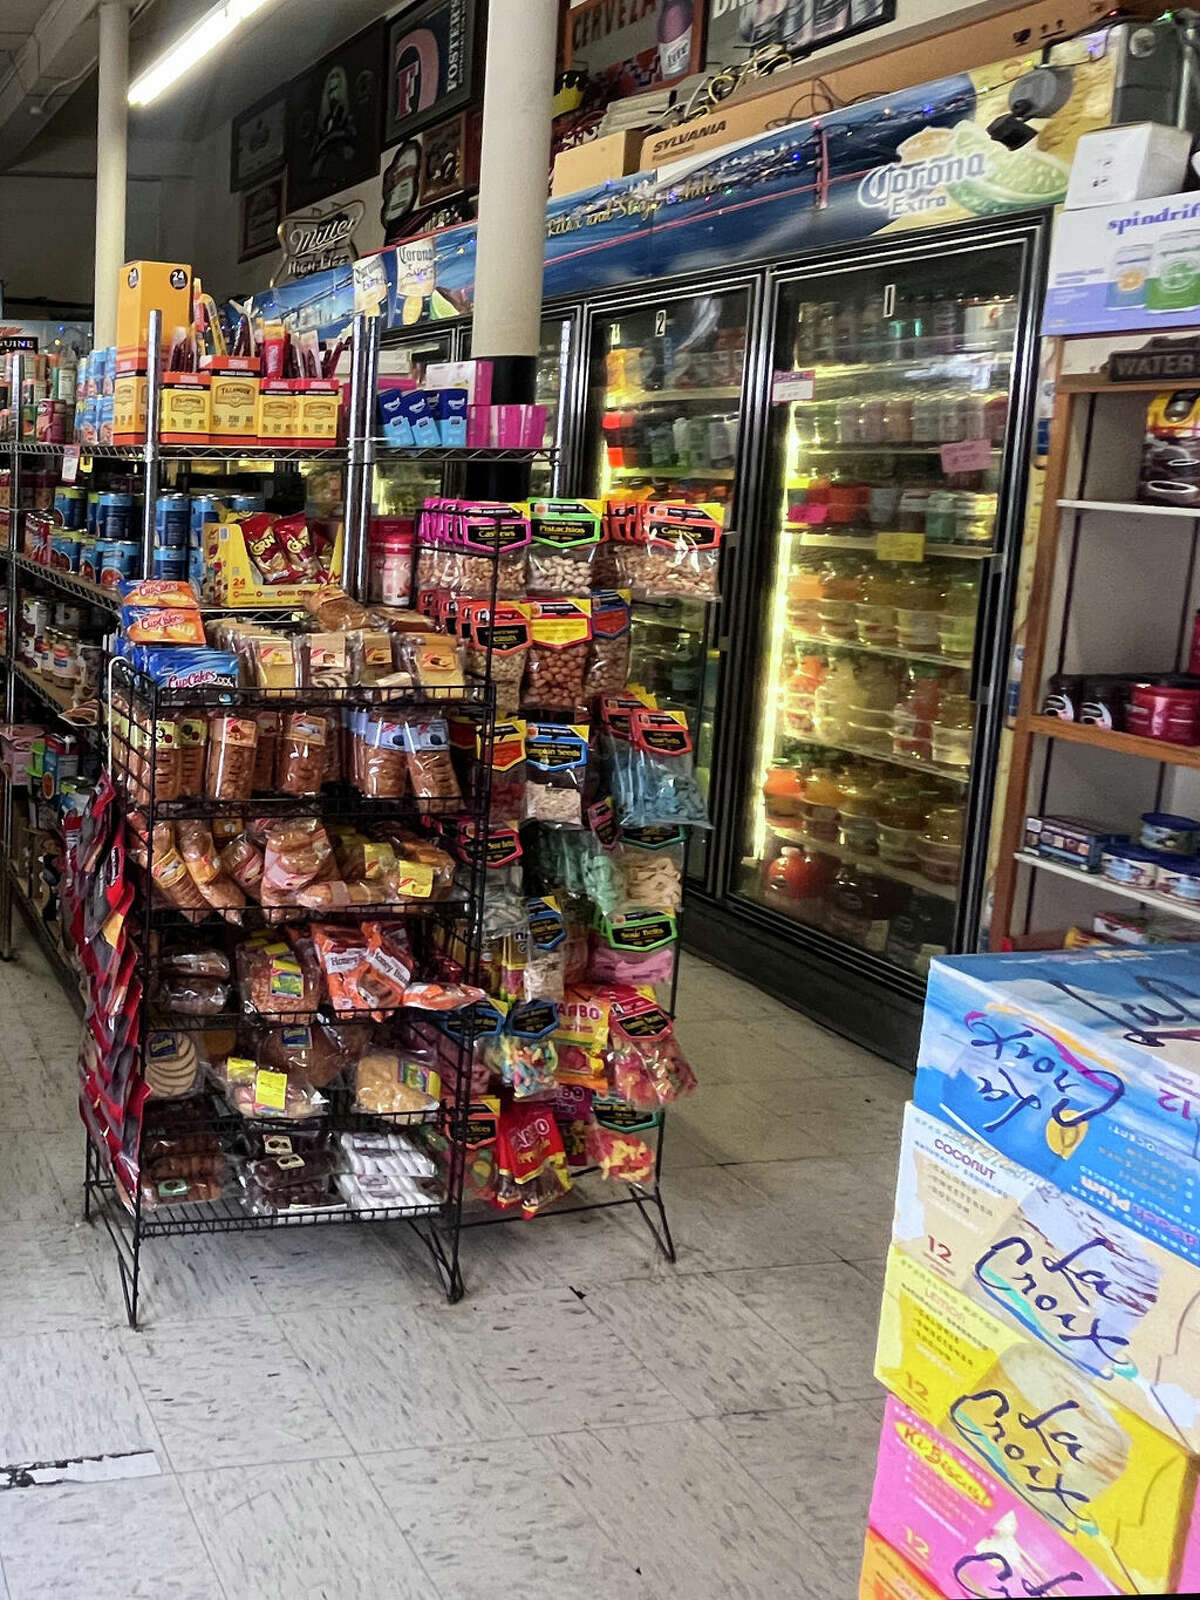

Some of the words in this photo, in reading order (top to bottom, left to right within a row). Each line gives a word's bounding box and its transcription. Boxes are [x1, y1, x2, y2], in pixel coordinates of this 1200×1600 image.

[654, 121, 727, 152] SYLVANIA
[858, 152, 986, 208] Corona
[888, 193, 947, 218] Extra
[1108, 203, 1200, 236] spindrif
[290, 217, 357, 256] Miller
[172, 271, 185, 281] 24
[656, 311, 666, 335] 2
[1115, 353, 1195, 375] WATER
[478, 529, 516, 538] Casews
[539, 524, 585, 535] Pistachios
[233, 577, 246, 588] 24
[1158, 1088, 1193, 1120] 12
[934, 1138, 997, 1181] COCONUT
[927, 1234, 952, 1263] 12
[1042, 1237, 1118, 1306] La
[975, 1236, 1130, 1366] Croix
[905, 1372, 929, 1398] 12
[1018, 1400, 1085, 1467] La
[950, 1389, 1091, 1522] Croix
[904, 1527, 931, 1557] 12
